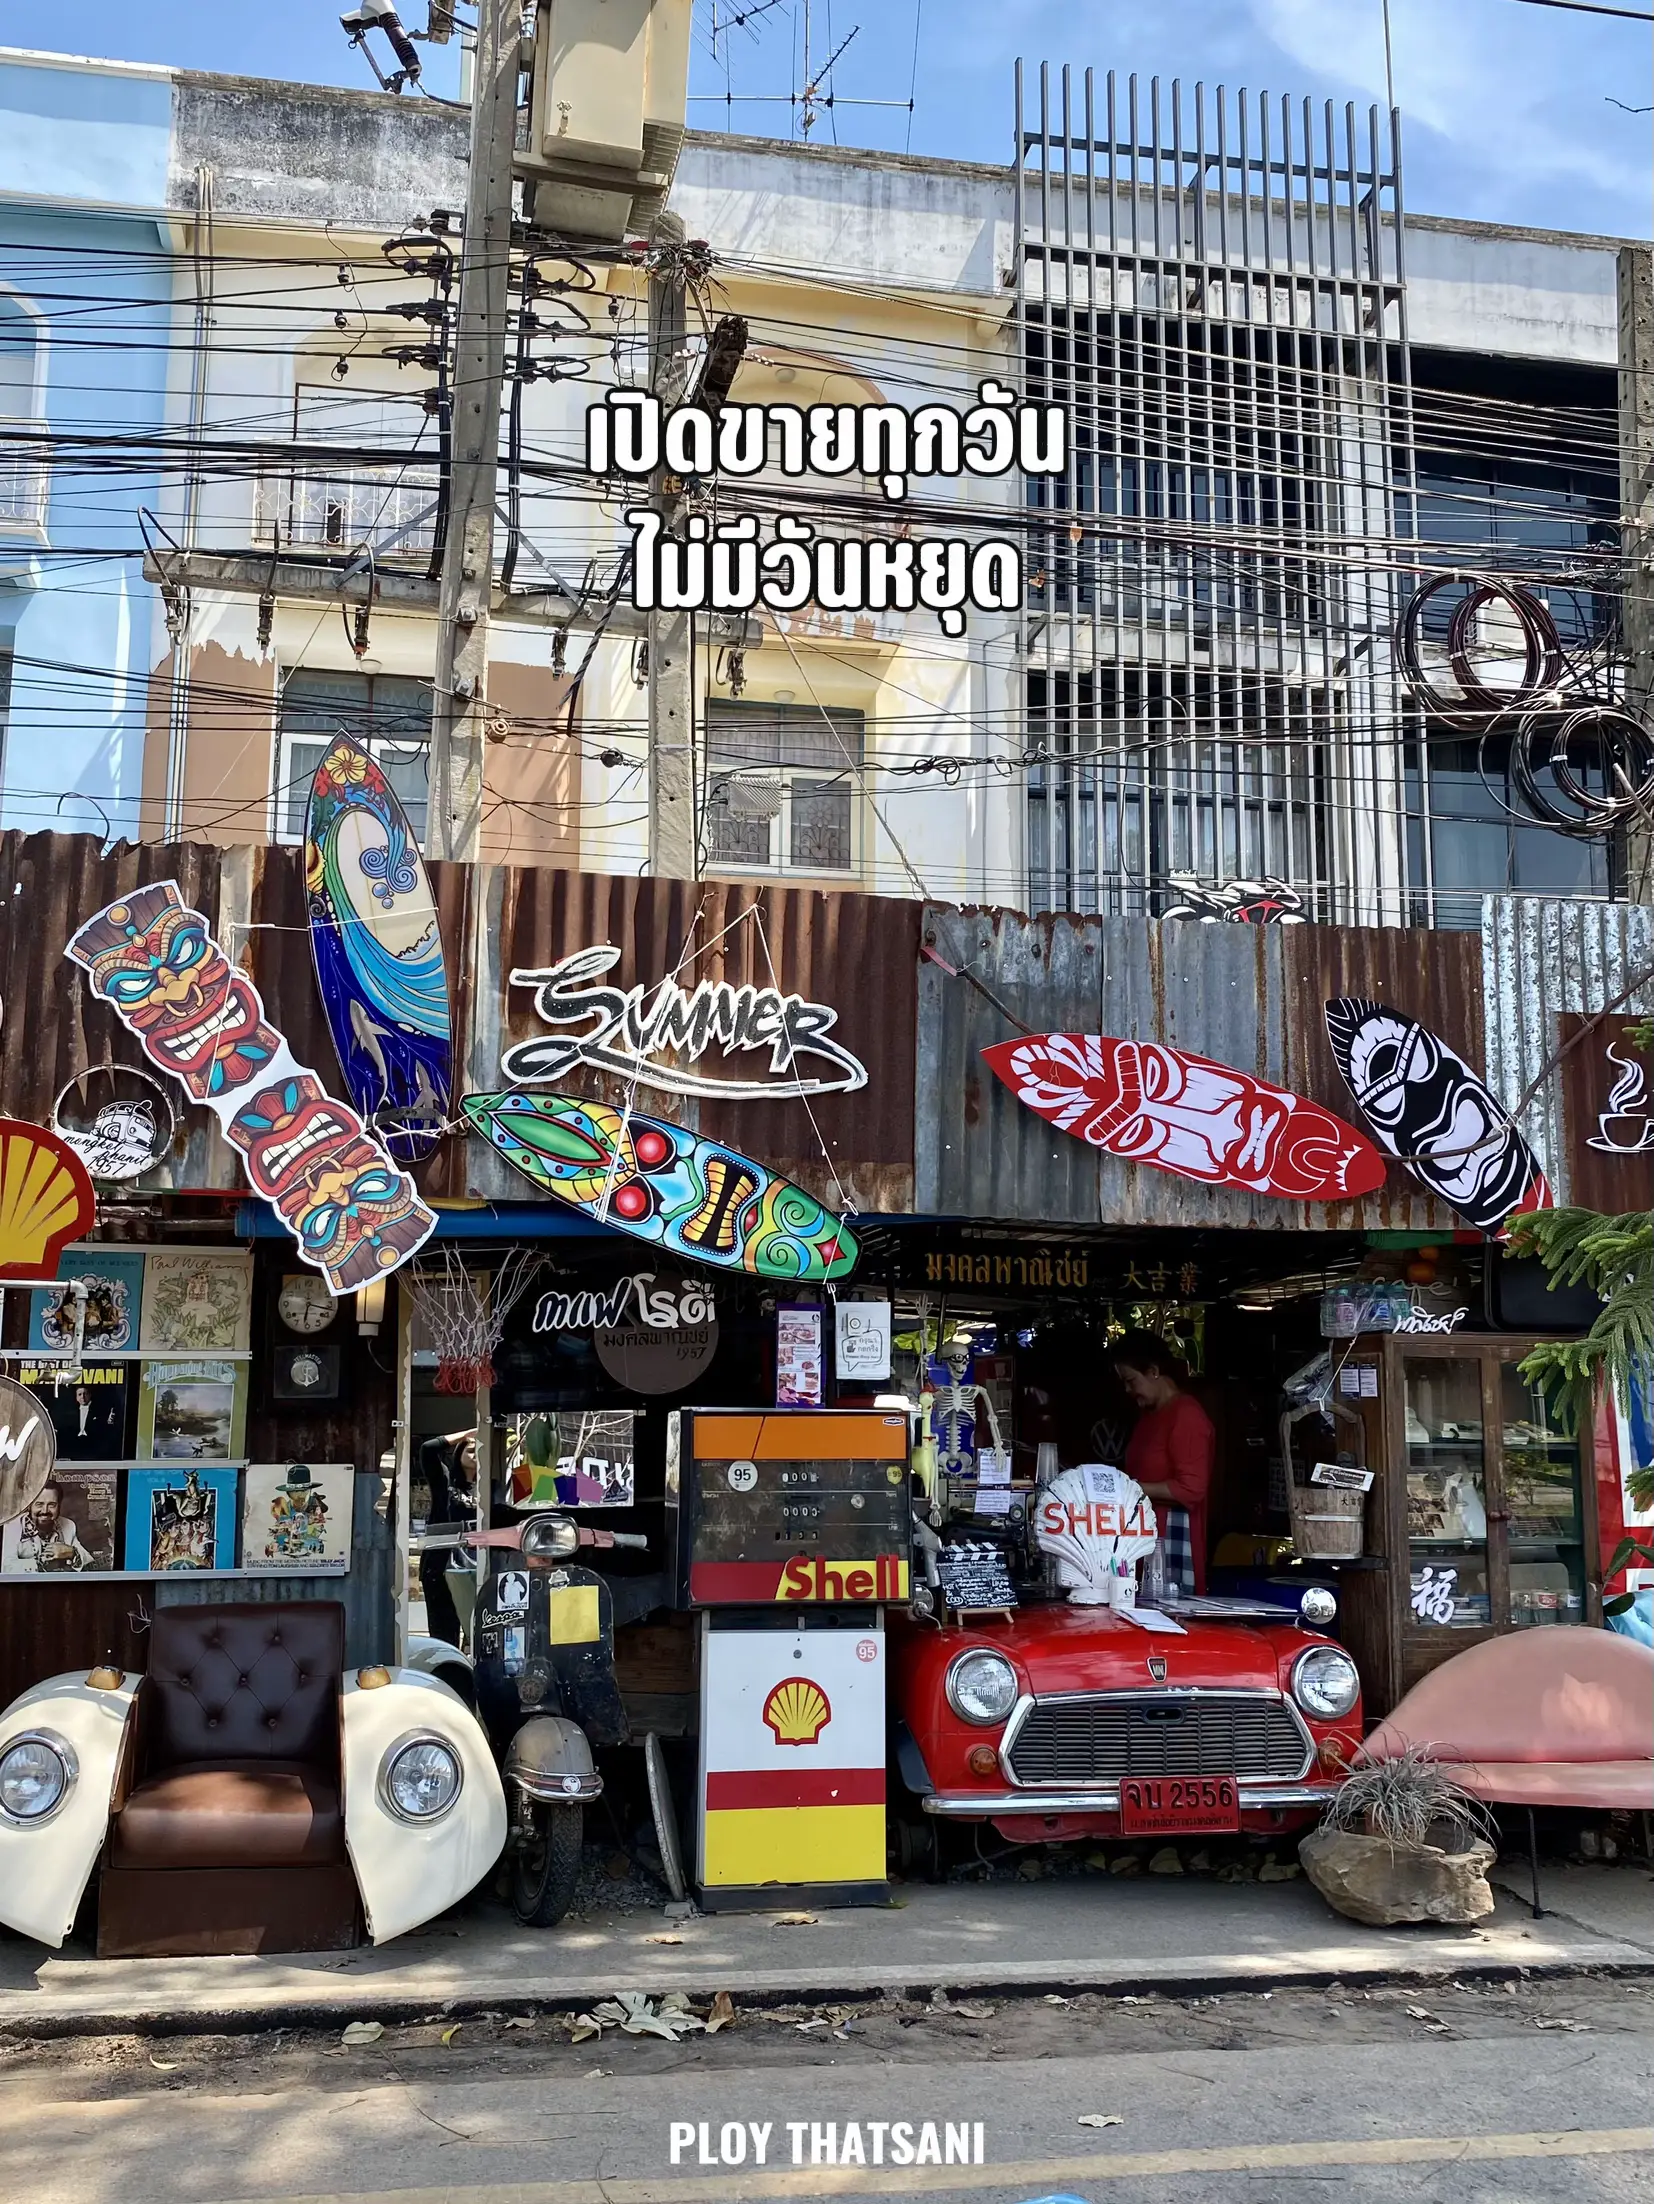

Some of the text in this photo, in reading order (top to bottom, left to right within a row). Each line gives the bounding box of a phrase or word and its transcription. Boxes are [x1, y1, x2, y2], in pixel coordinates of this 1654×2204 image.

[20, 1360, 36, 1369] THE
[734, 1468, 751, 1481] 95
[1044, 1502, 1155, 1537] SHELL
[784, 1554, 899, 1601] Shell
[1411, 1567, 1457, 1625] 福
[481, 1608, 525, 1629] Vespa
[859, 1646, 875, 1659] 95
[1169, 1779, 1233, 1809] 2556
